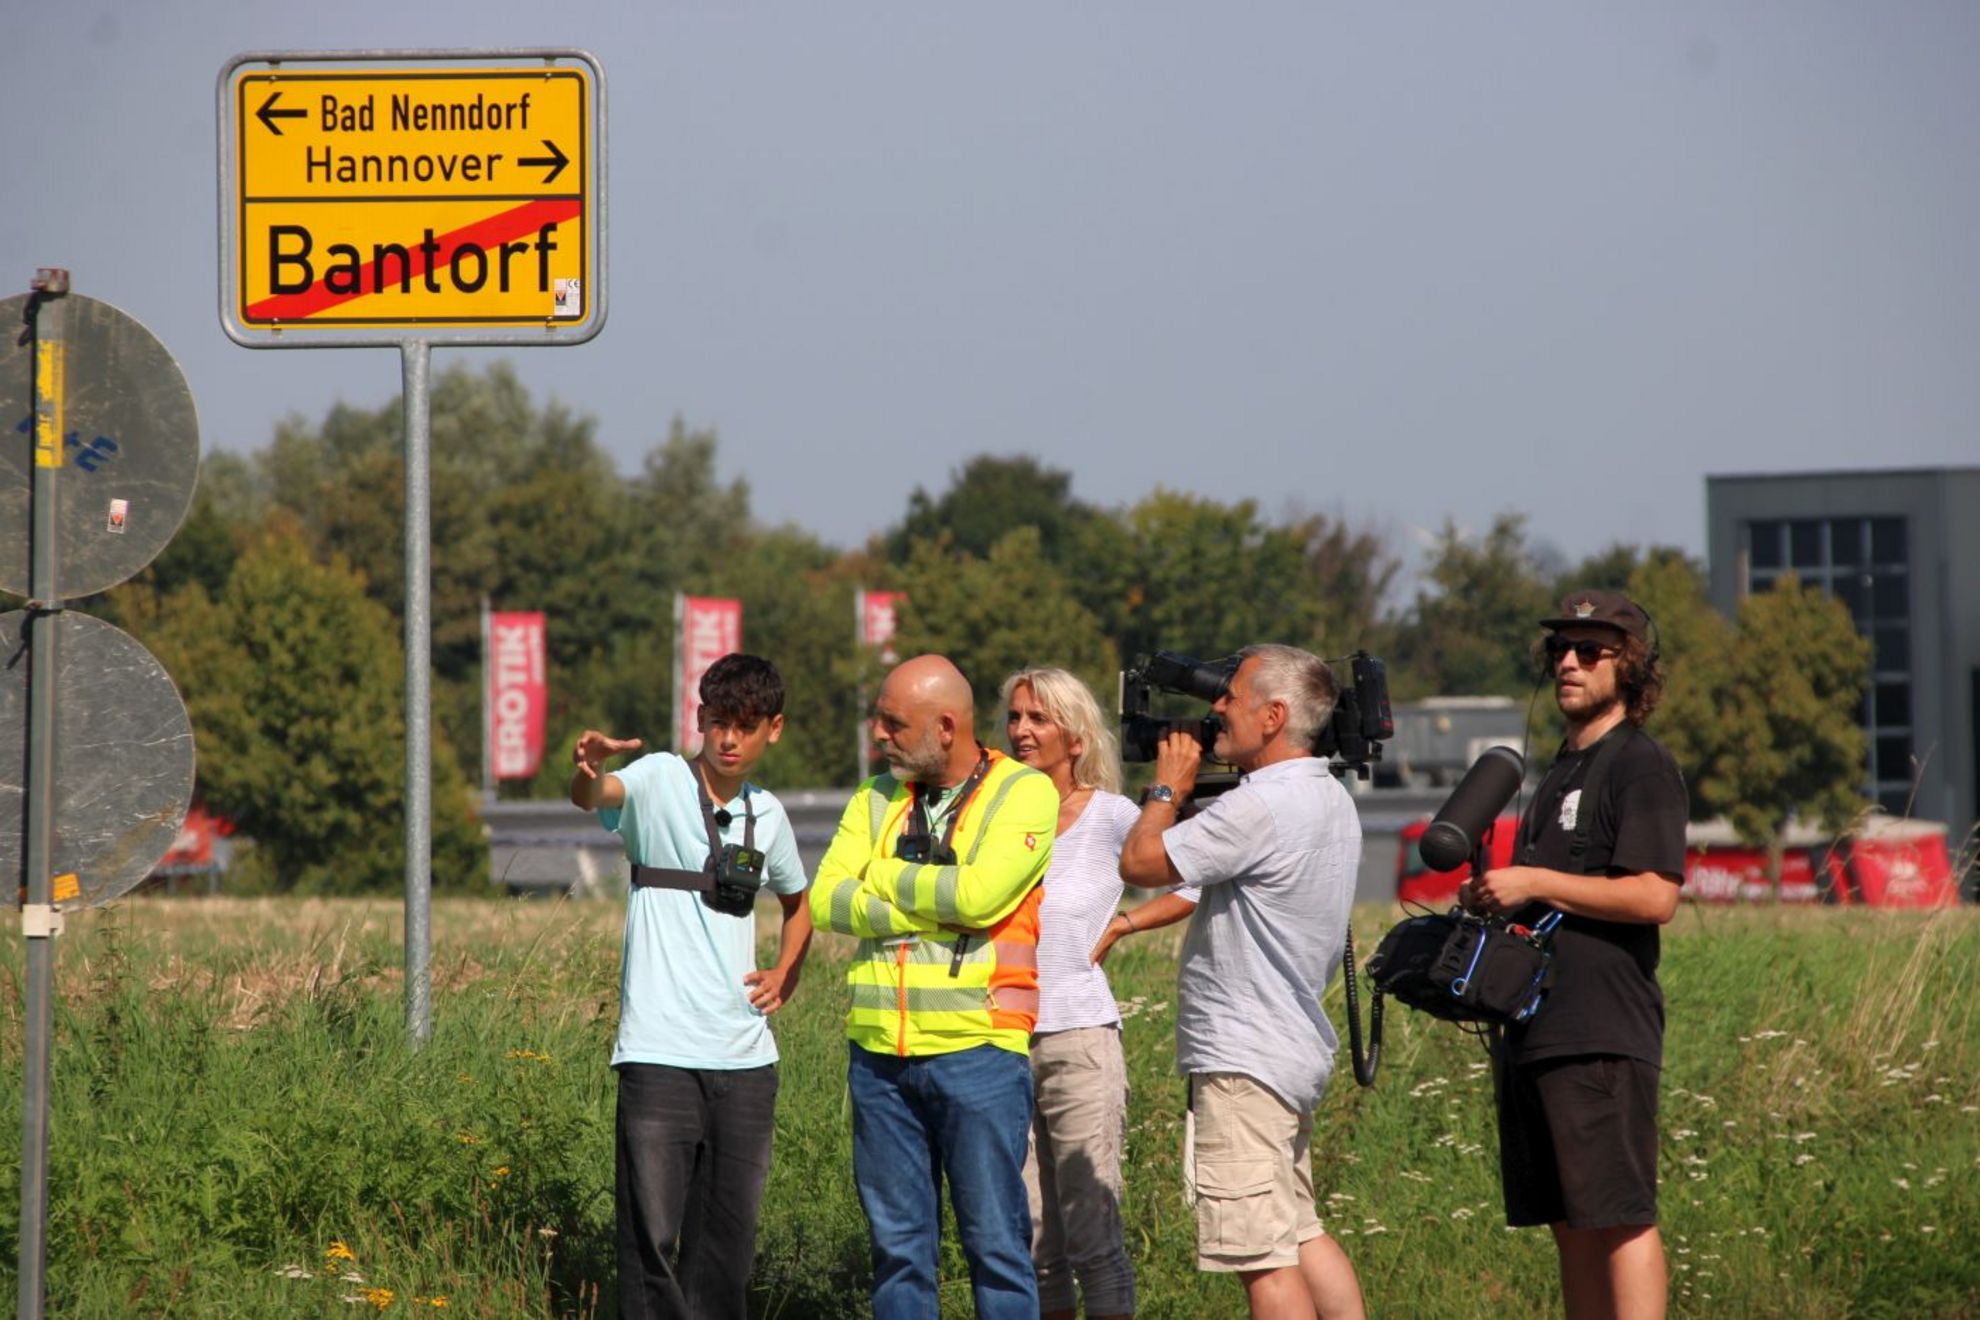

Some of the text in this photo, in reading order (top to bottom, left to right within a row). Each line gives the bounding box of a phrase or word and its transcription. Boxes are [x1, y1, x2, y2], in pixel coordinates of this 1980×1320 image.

[321, 93, 530, 132] Bad Nenndorf
[306, 145, 503, 183] Hannover
[269, 222, 558, 295] Bantorf
[498, 624, 528, 773] EROTIK
